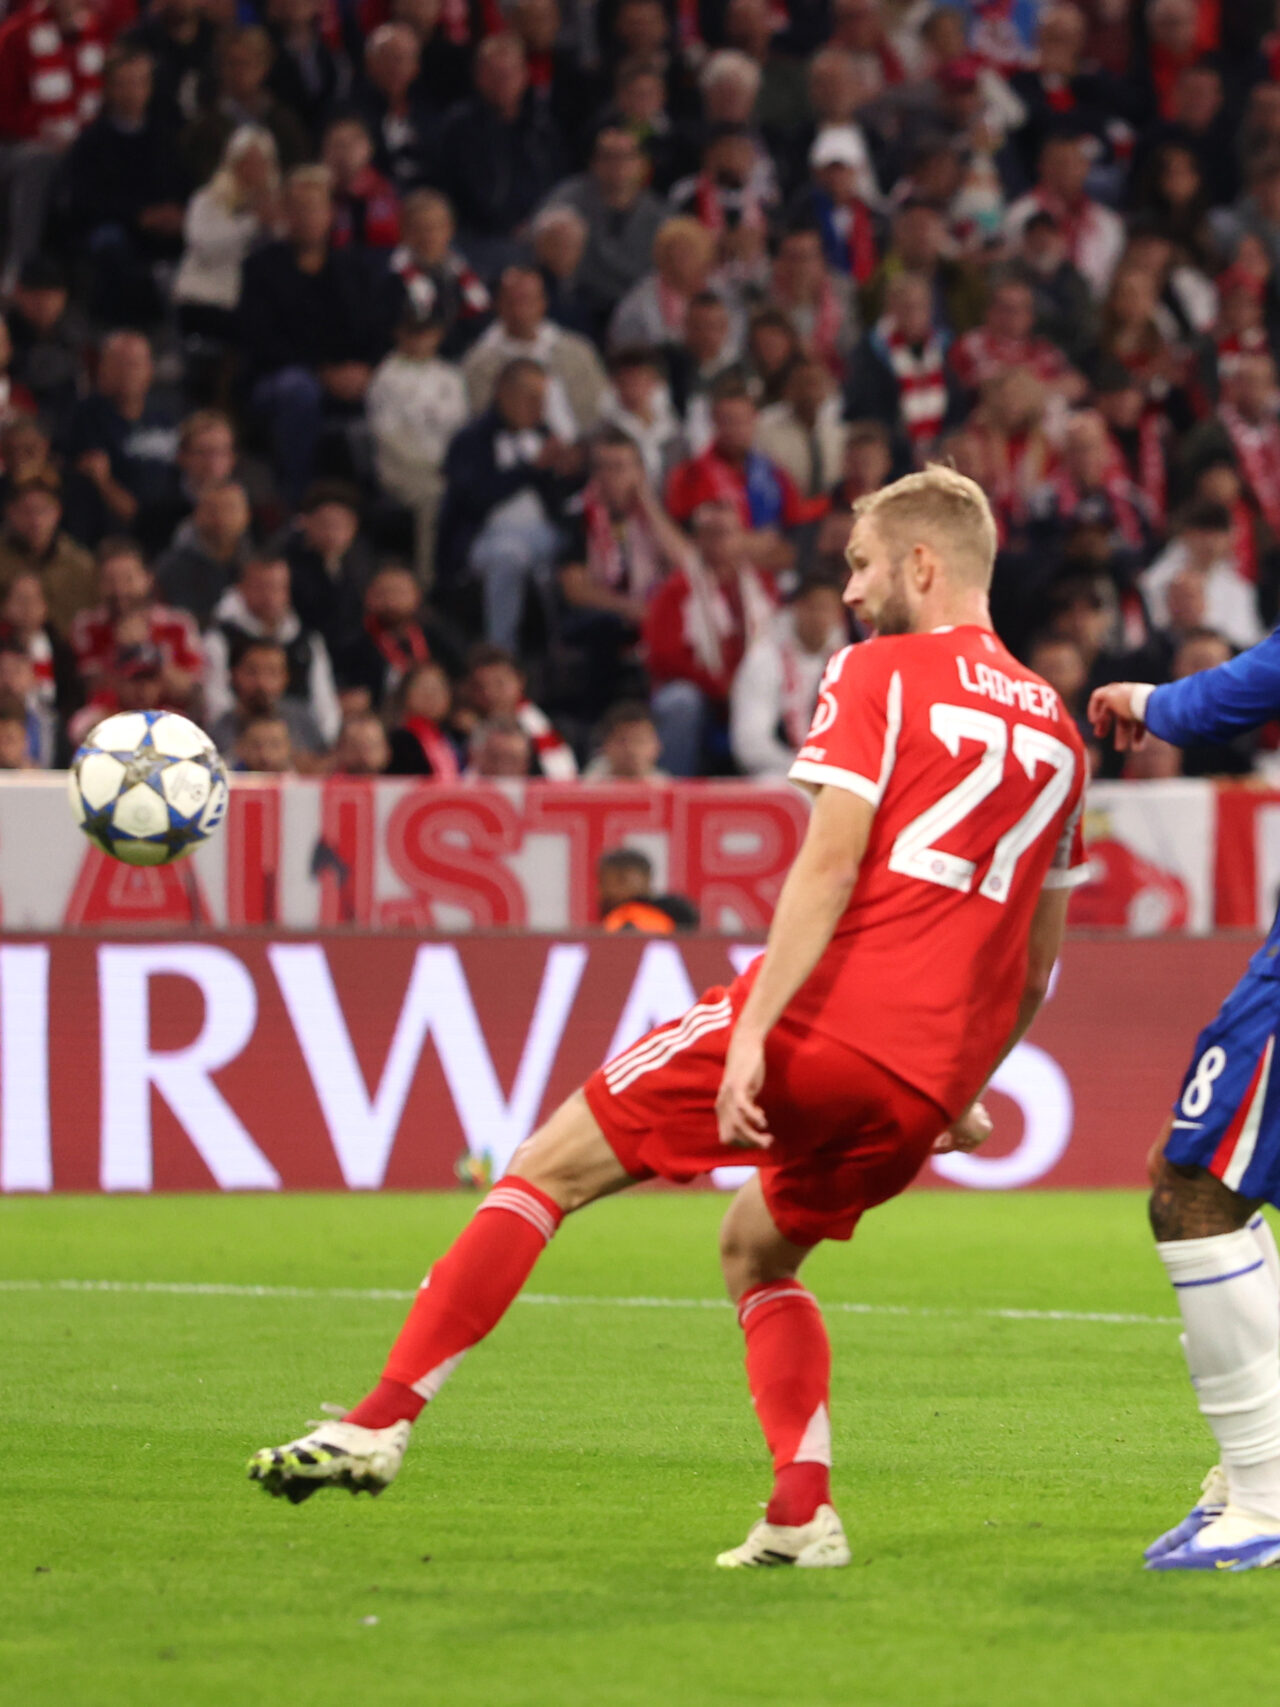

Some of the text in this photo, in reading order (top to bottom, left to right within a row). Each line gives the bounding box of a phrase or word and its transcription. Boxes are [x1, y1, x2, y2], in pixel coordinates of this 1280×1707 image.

[956, 655, 1059, 722] LAIMER
[888, 702, 1075, 904] 27
[1181, 1045, 1227, 1118] 8
